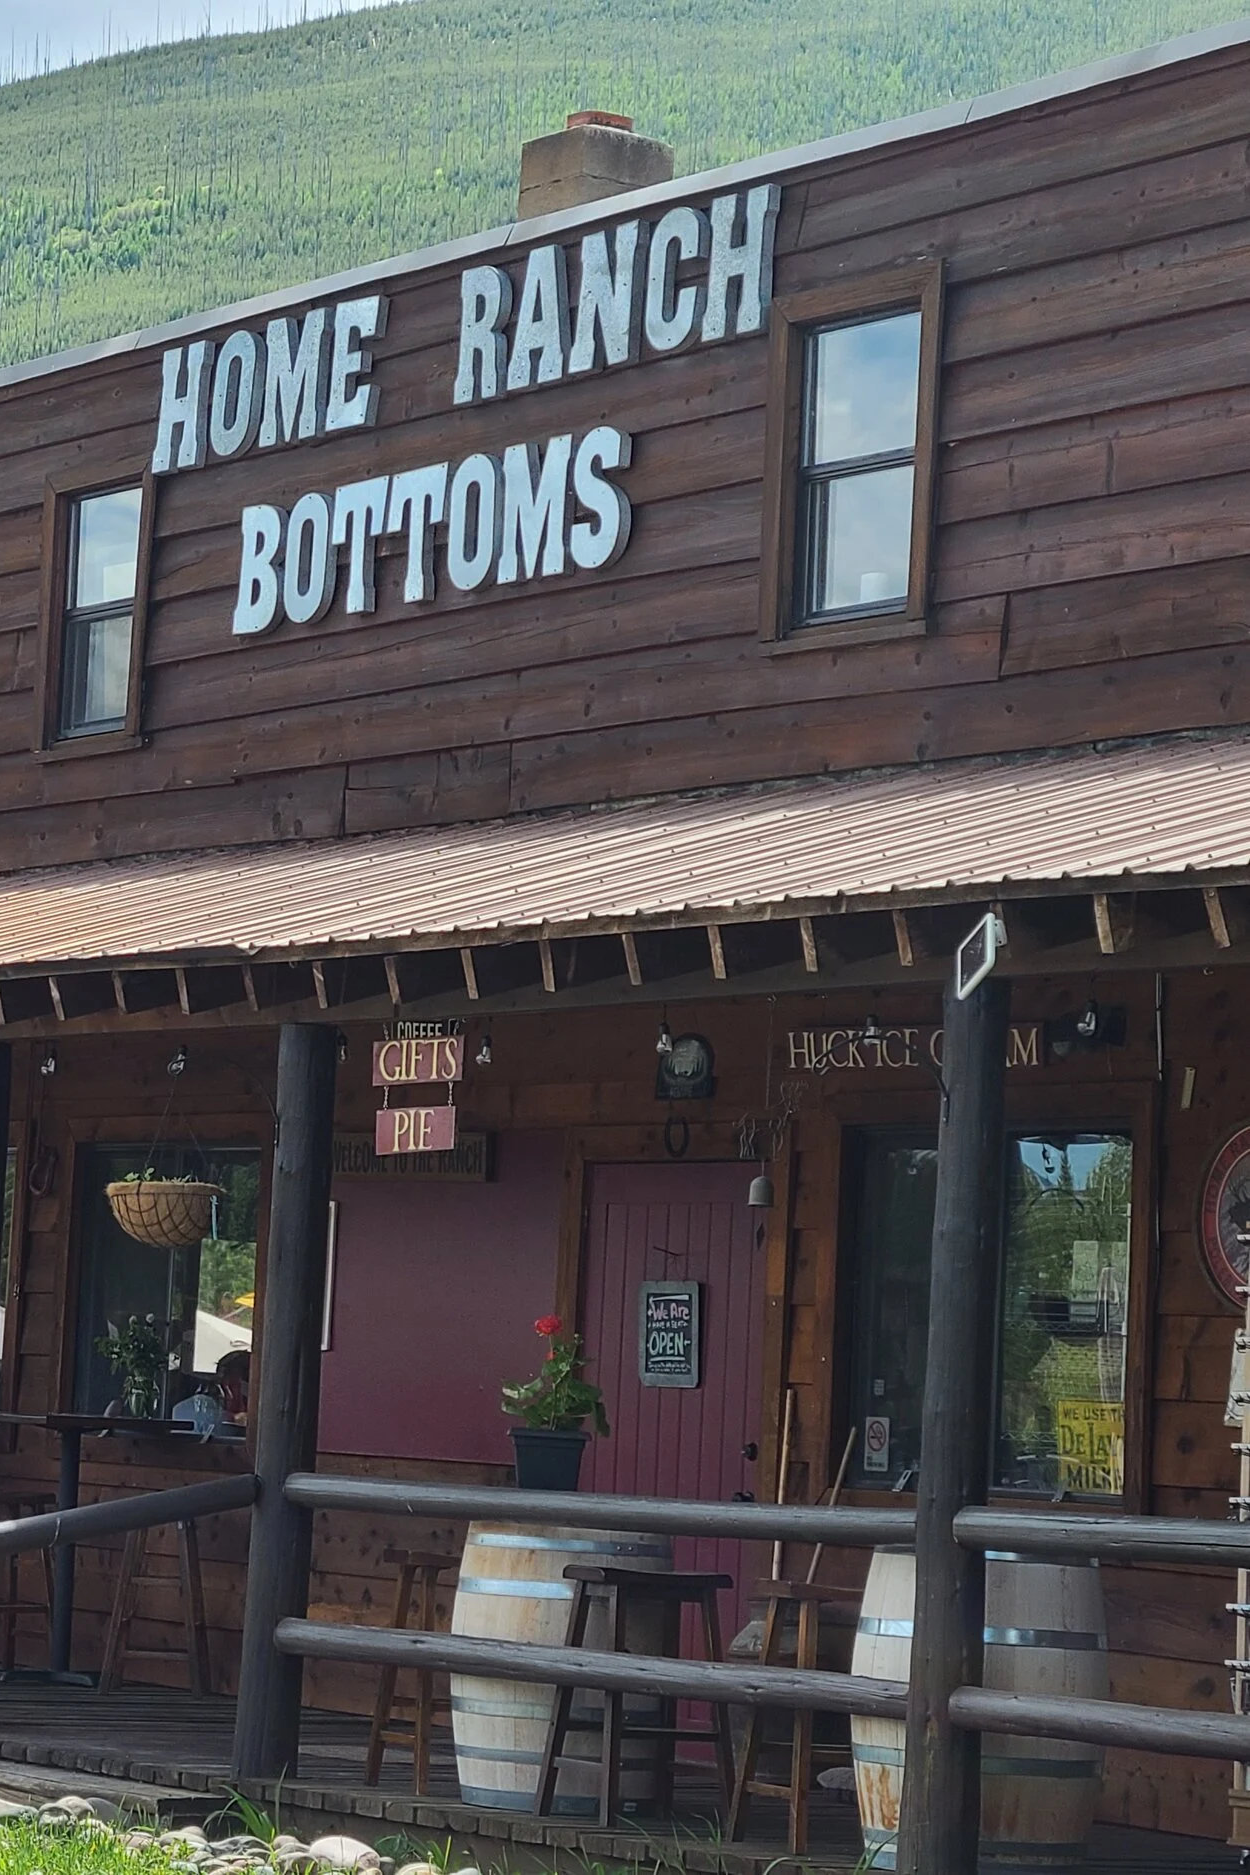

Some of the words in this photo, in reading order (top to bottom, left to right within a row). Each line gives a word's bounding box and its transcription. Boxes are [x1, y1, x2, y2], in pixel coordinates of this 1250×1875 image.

[151, 294, 390, 475] HOME
[454, 183, 781, 405] RANCH
[232, 426, 632, 636] BOTTOMS
[397, 1021, 443, 1039] COFFEE
[379, 1037, 458, 1082] GIFTS
[392, 1109, 435, 1152] PIE
[649, 1301, 669, 1320] We
[670, 1302, 690, 1320] Are
[649, 1331, 684, 1355] OPEN
[1063, 1407, 1079, 1420] WE
[1083, 1408, 1106, 1421] USE
